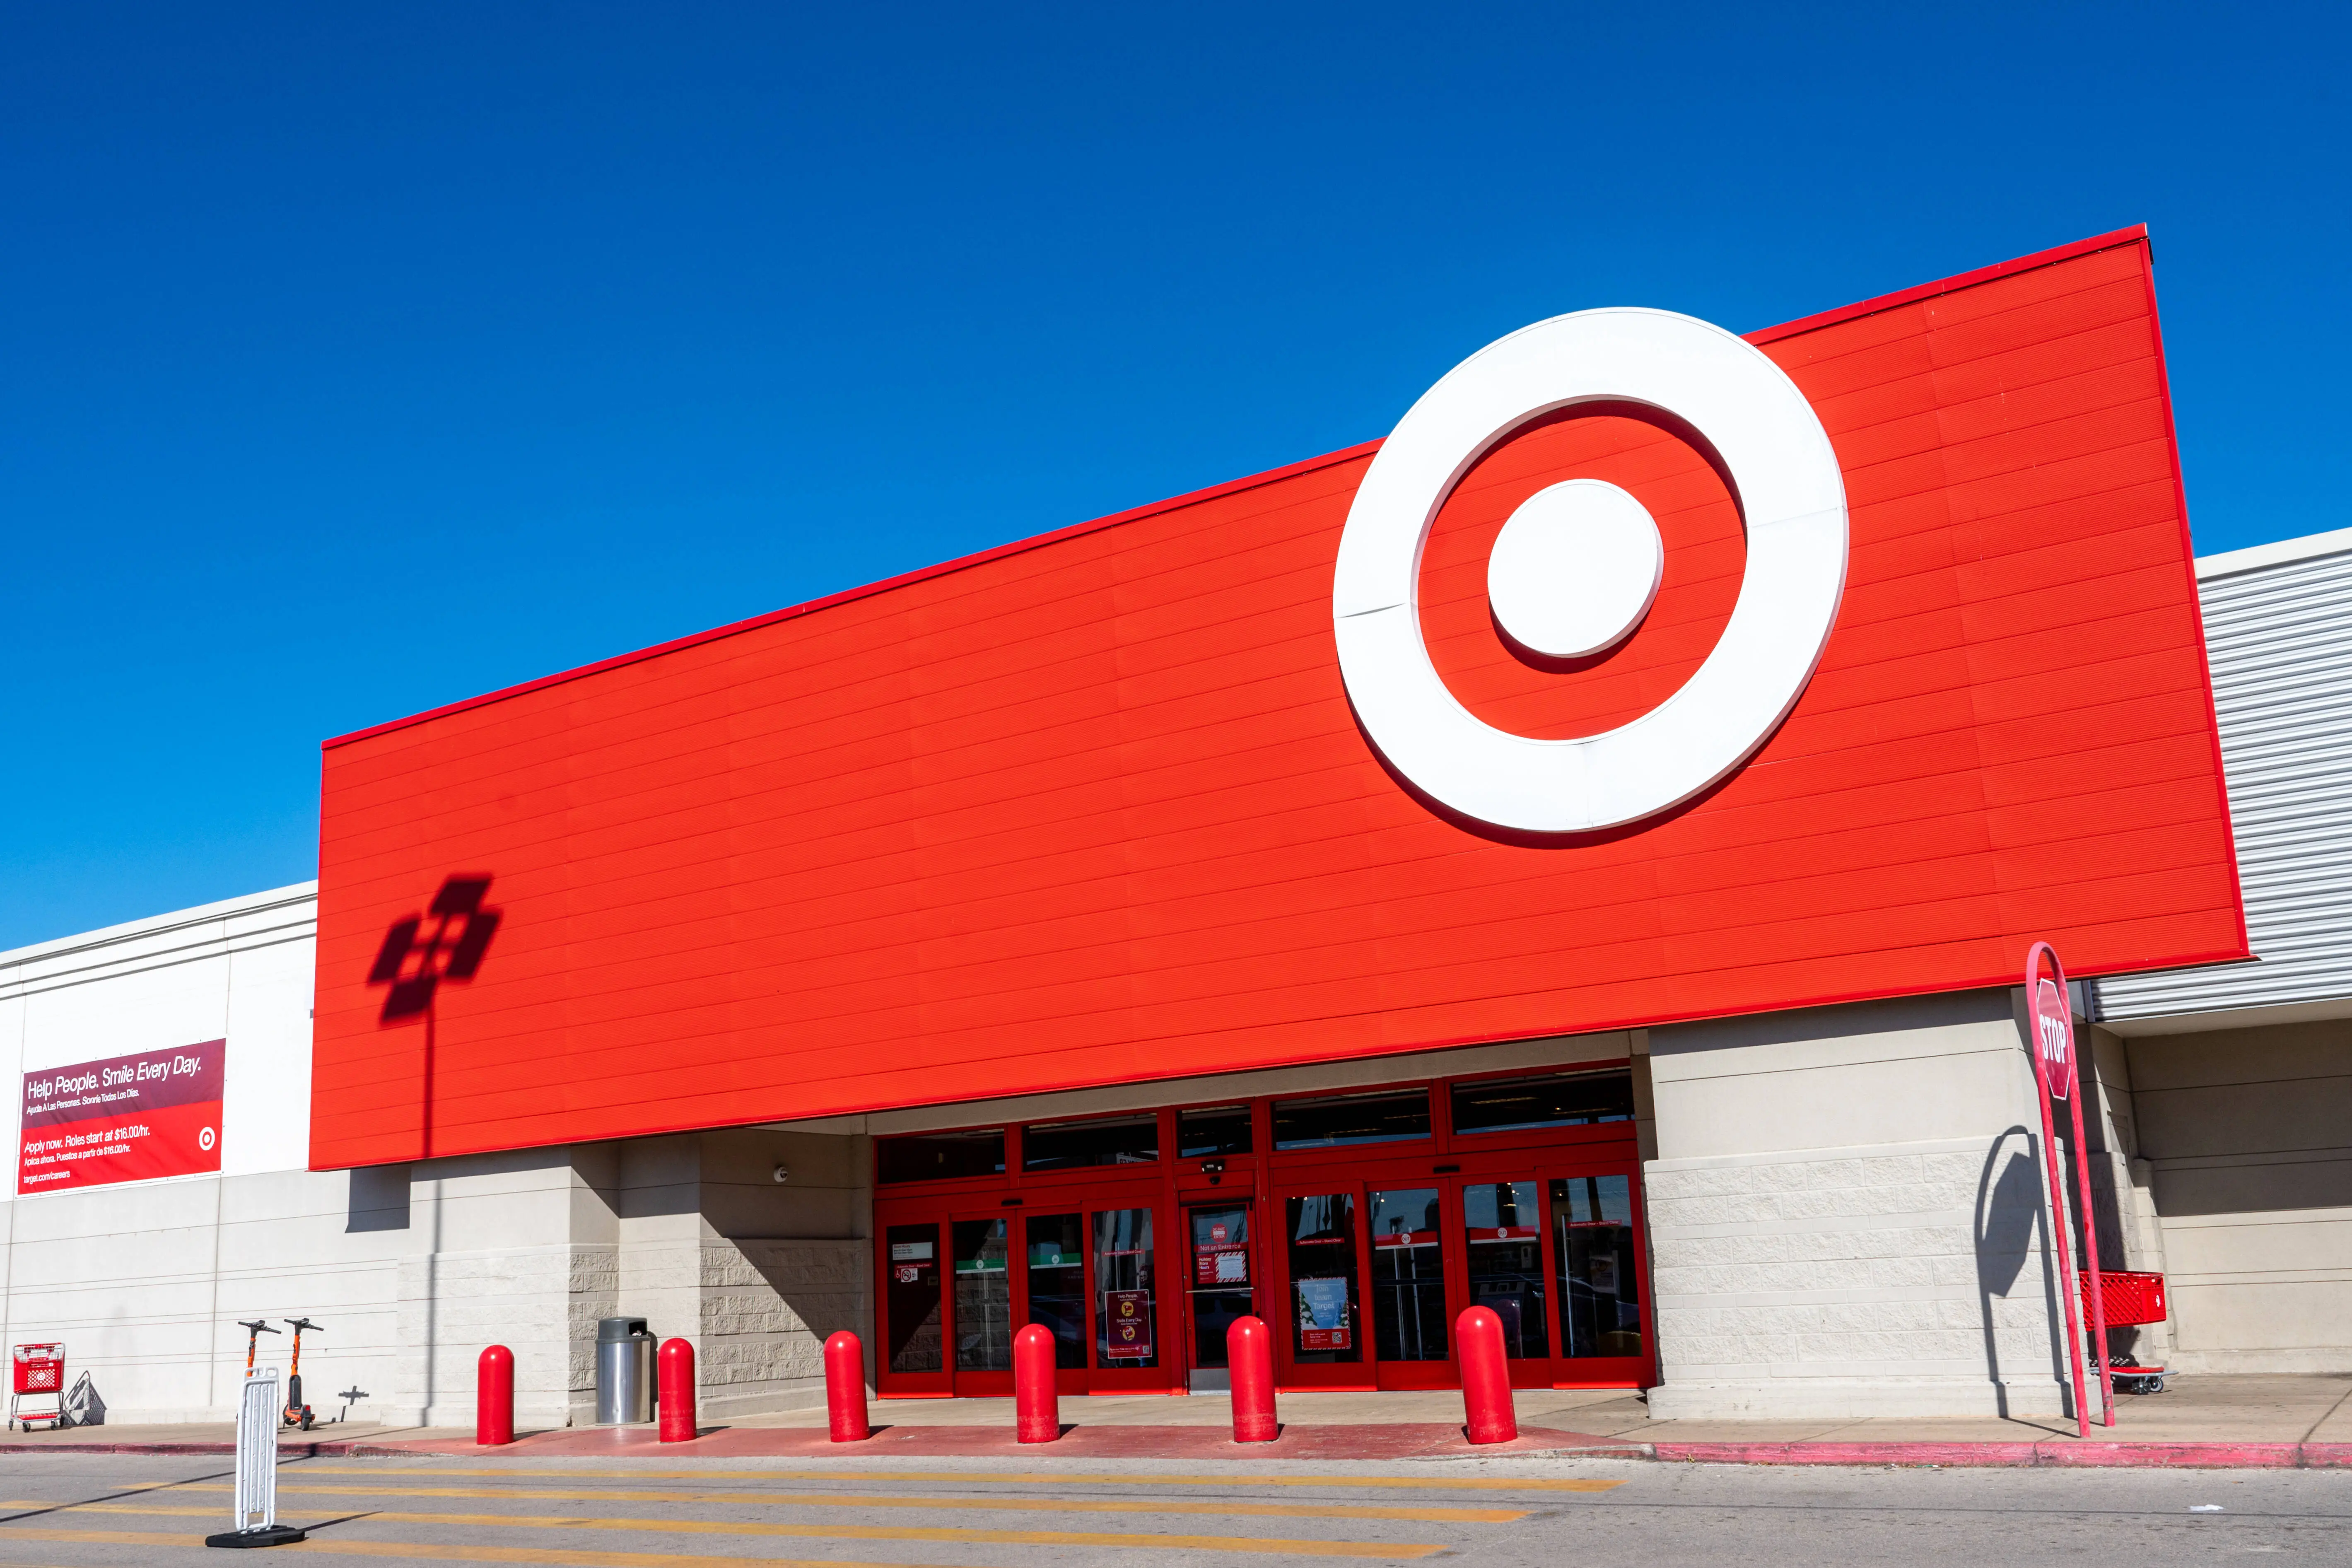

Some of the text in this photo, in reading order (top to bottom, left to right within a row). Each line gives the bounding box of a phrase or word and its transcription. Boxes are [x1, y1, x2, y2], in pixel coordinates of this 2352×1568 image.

[2039, 1014, 2066, 1064] STOP
[28, 1056, 201, 1101] Help People. Smile Every Day.
[27, 1105, 42, 1116] Ayuda
[42, 1103, 47, 1112] A
[47, 1102, 56, 1111] Las
[57, 1099, 81, 1109] Personas.
[101, 1093, 116, 1102] Todos
[117, 1091, 126, 1100] Los
[24, 1124, 150, 1155] Apply now. Roles start at $16.00/hr.
[40, 1154, 55, 1164] ahora.
[56, 1152, 77, 1163] Puestos
[82, 1148, 95, 1160] partir
[96, 1148, 103, 1157] de
[104, 1144, 130, 1155] $16.00/hr.
[24, 1170, 70, 1184] target.com/careers
[1313, 1302, 1334, 1310] Target
